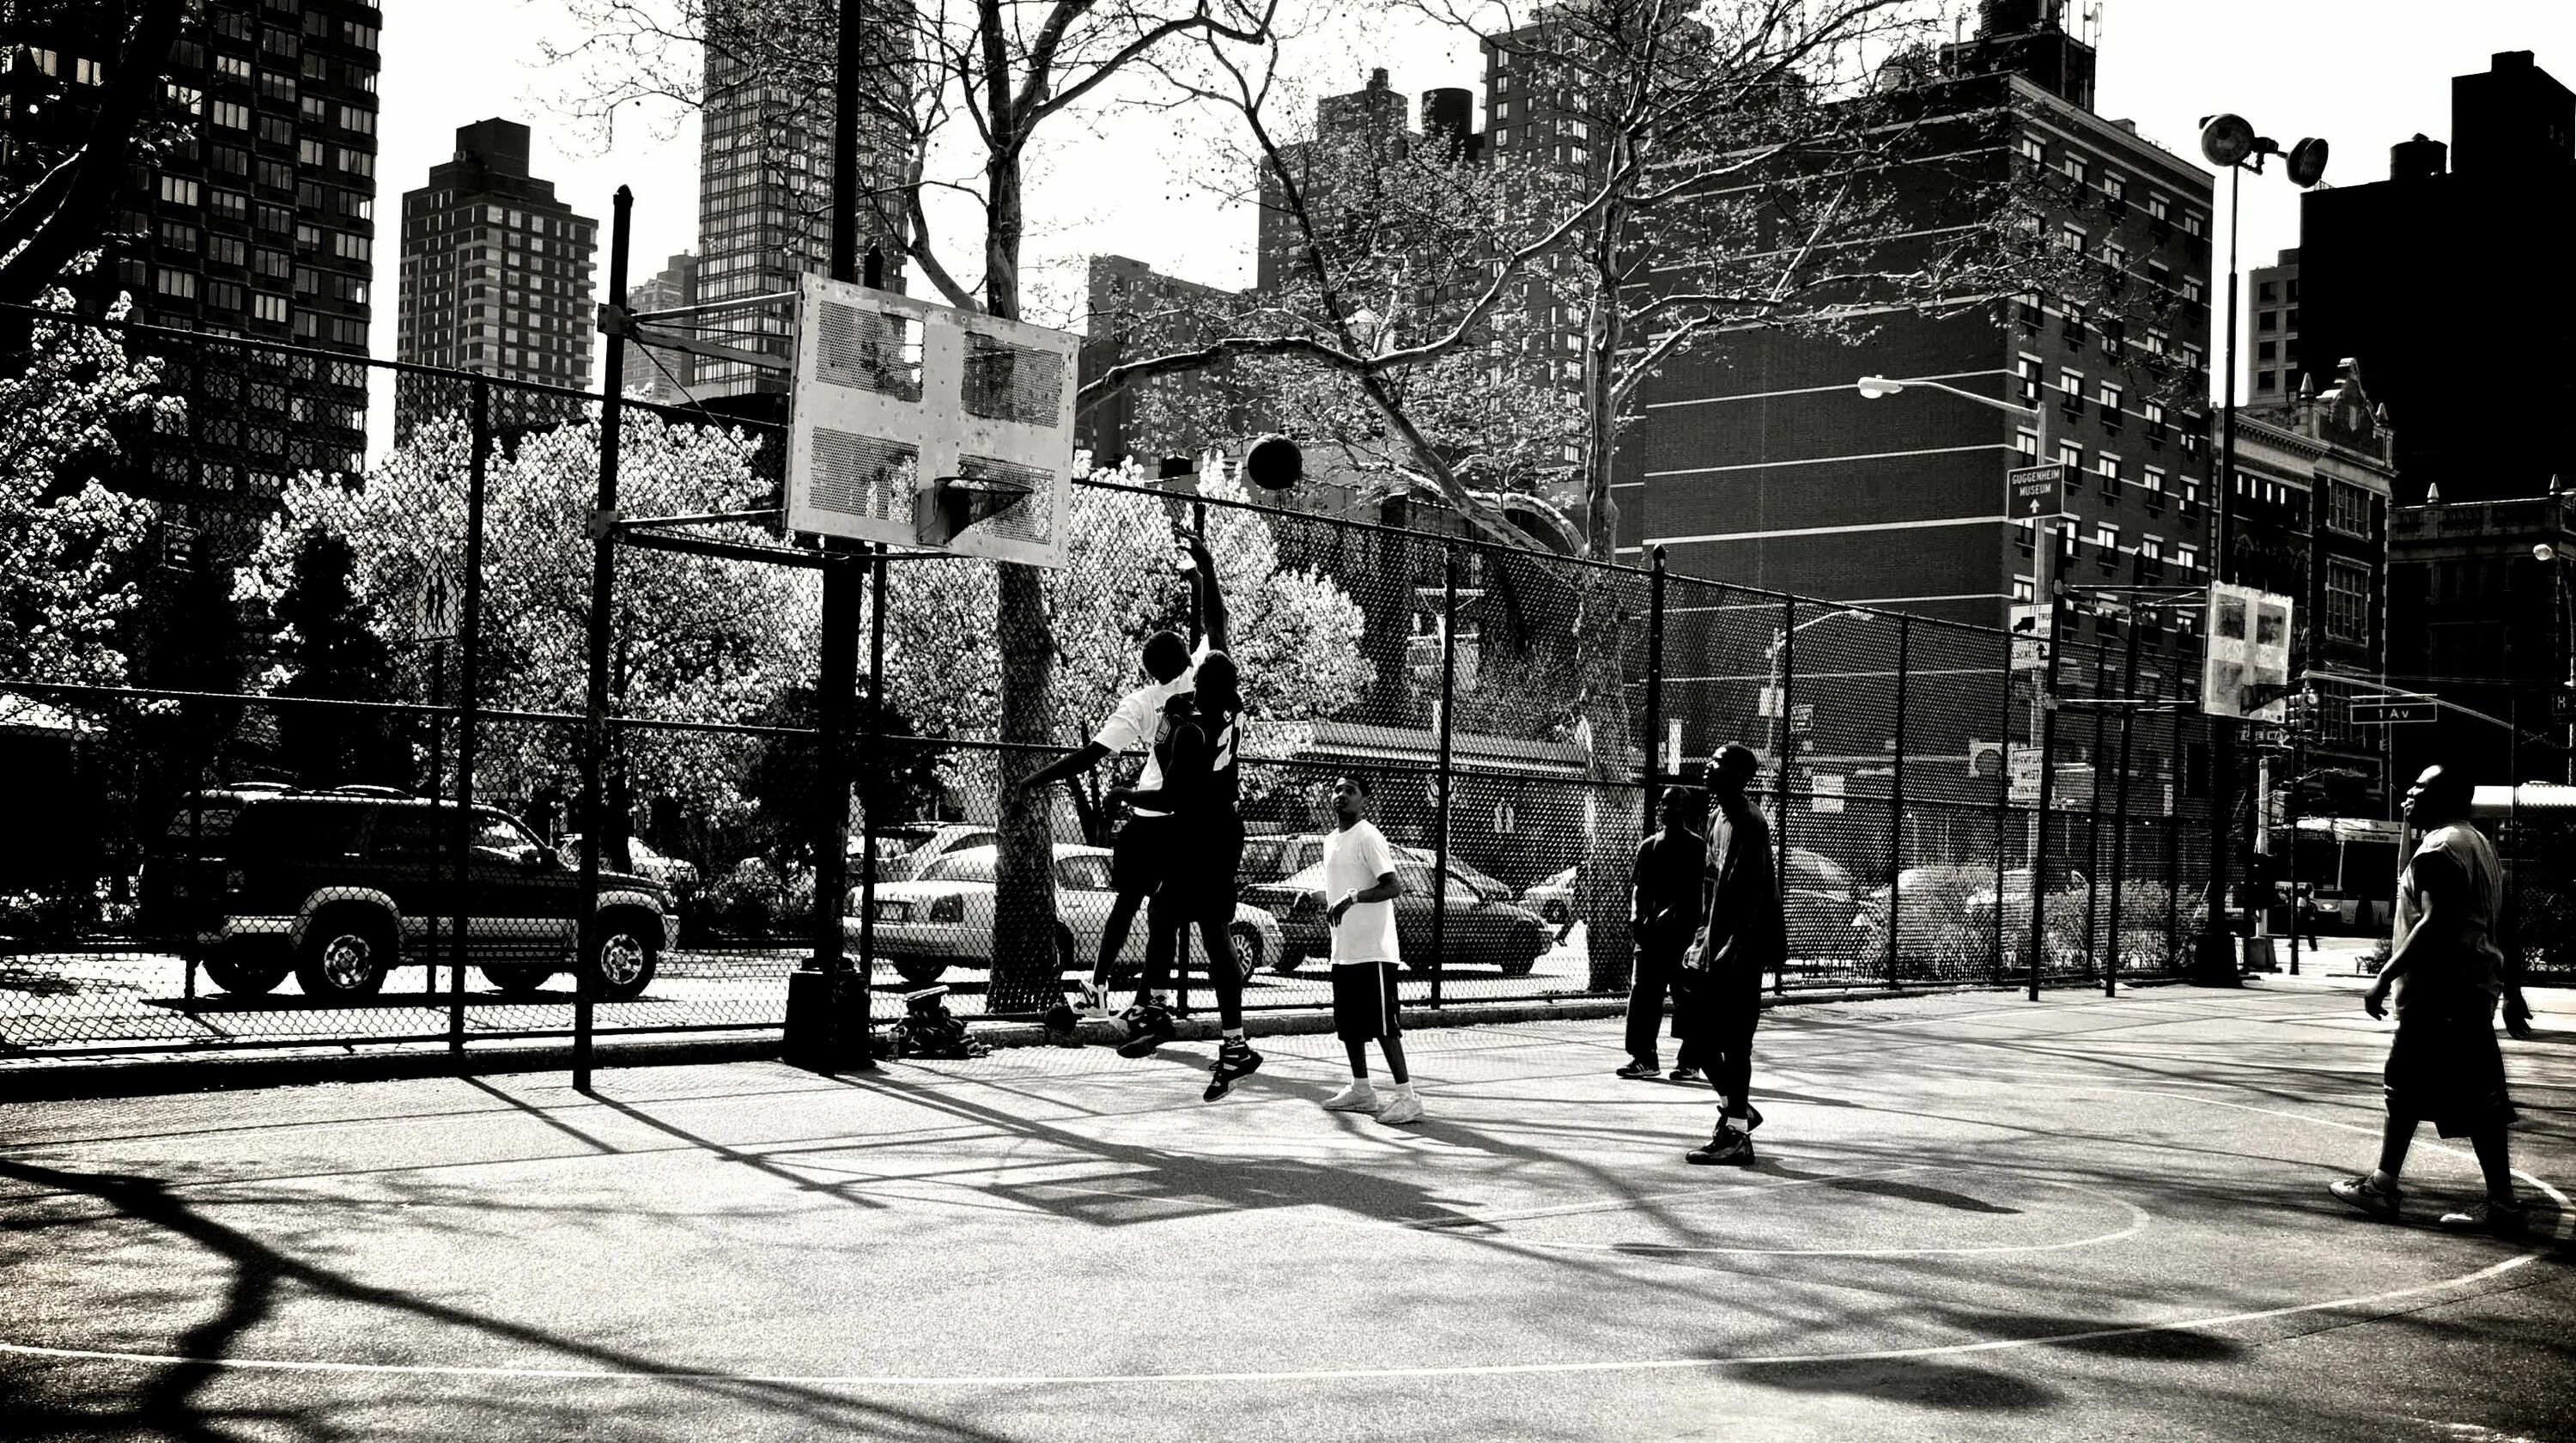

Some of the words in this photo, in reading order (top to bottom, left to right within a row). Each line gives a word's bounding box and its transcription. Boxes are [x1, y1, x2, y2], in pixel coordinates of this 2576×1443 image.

[2012, 469, 2060, 484] GUGGENHEIM
[2020, 483, 2051, 496] MUSEUM
[2038, 612, 2051, 621] TRU
[2379, 709, 2384, 719] 1
[2390, 708, 2409, 719] Av
